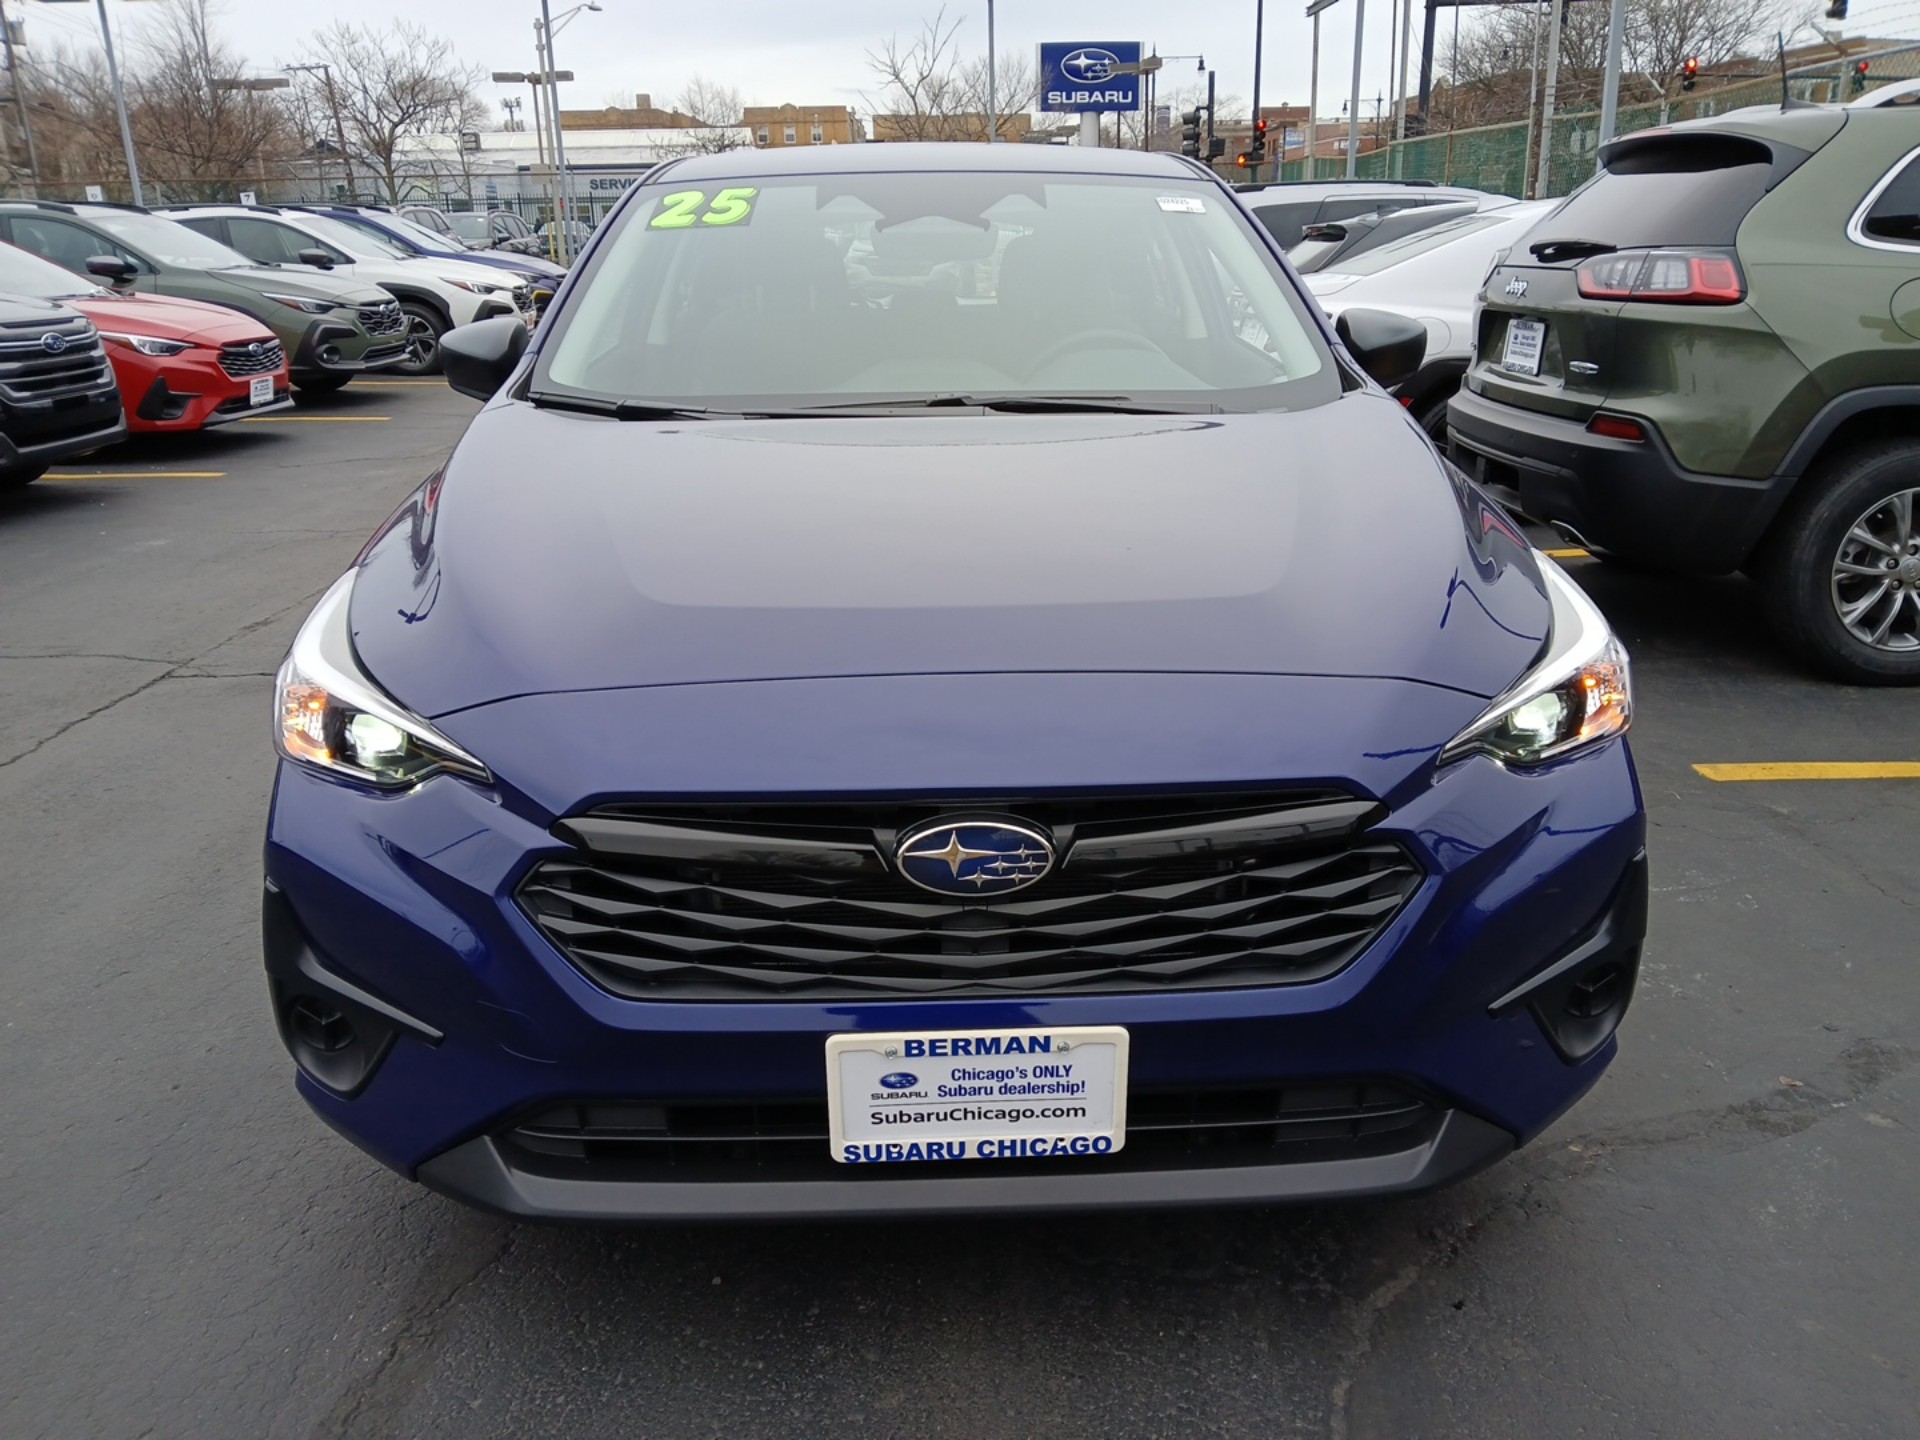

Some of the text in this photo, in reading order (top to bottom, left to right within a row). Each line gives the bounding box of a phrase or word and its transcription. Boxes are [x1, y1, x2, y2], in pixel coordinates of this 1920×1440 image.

[1047, 90, 1133, 104] SUBARU
[590, 178, 639, 190] SERVI
[650, 187, 757, 228] 25
[904, 1036, 1051, 1058] BERMAN
[951, 1065, 1073, 1082] Chicago's ONLY
[871, 1091, 928, 1100] SUBARU
[937, 1081, 1086, 1098] Subaru dealership!
[870, 1105, 1087, 1125] SubaruChicago.com
[843, 1135, 1113, 1164] SUBARU CHICAGO
